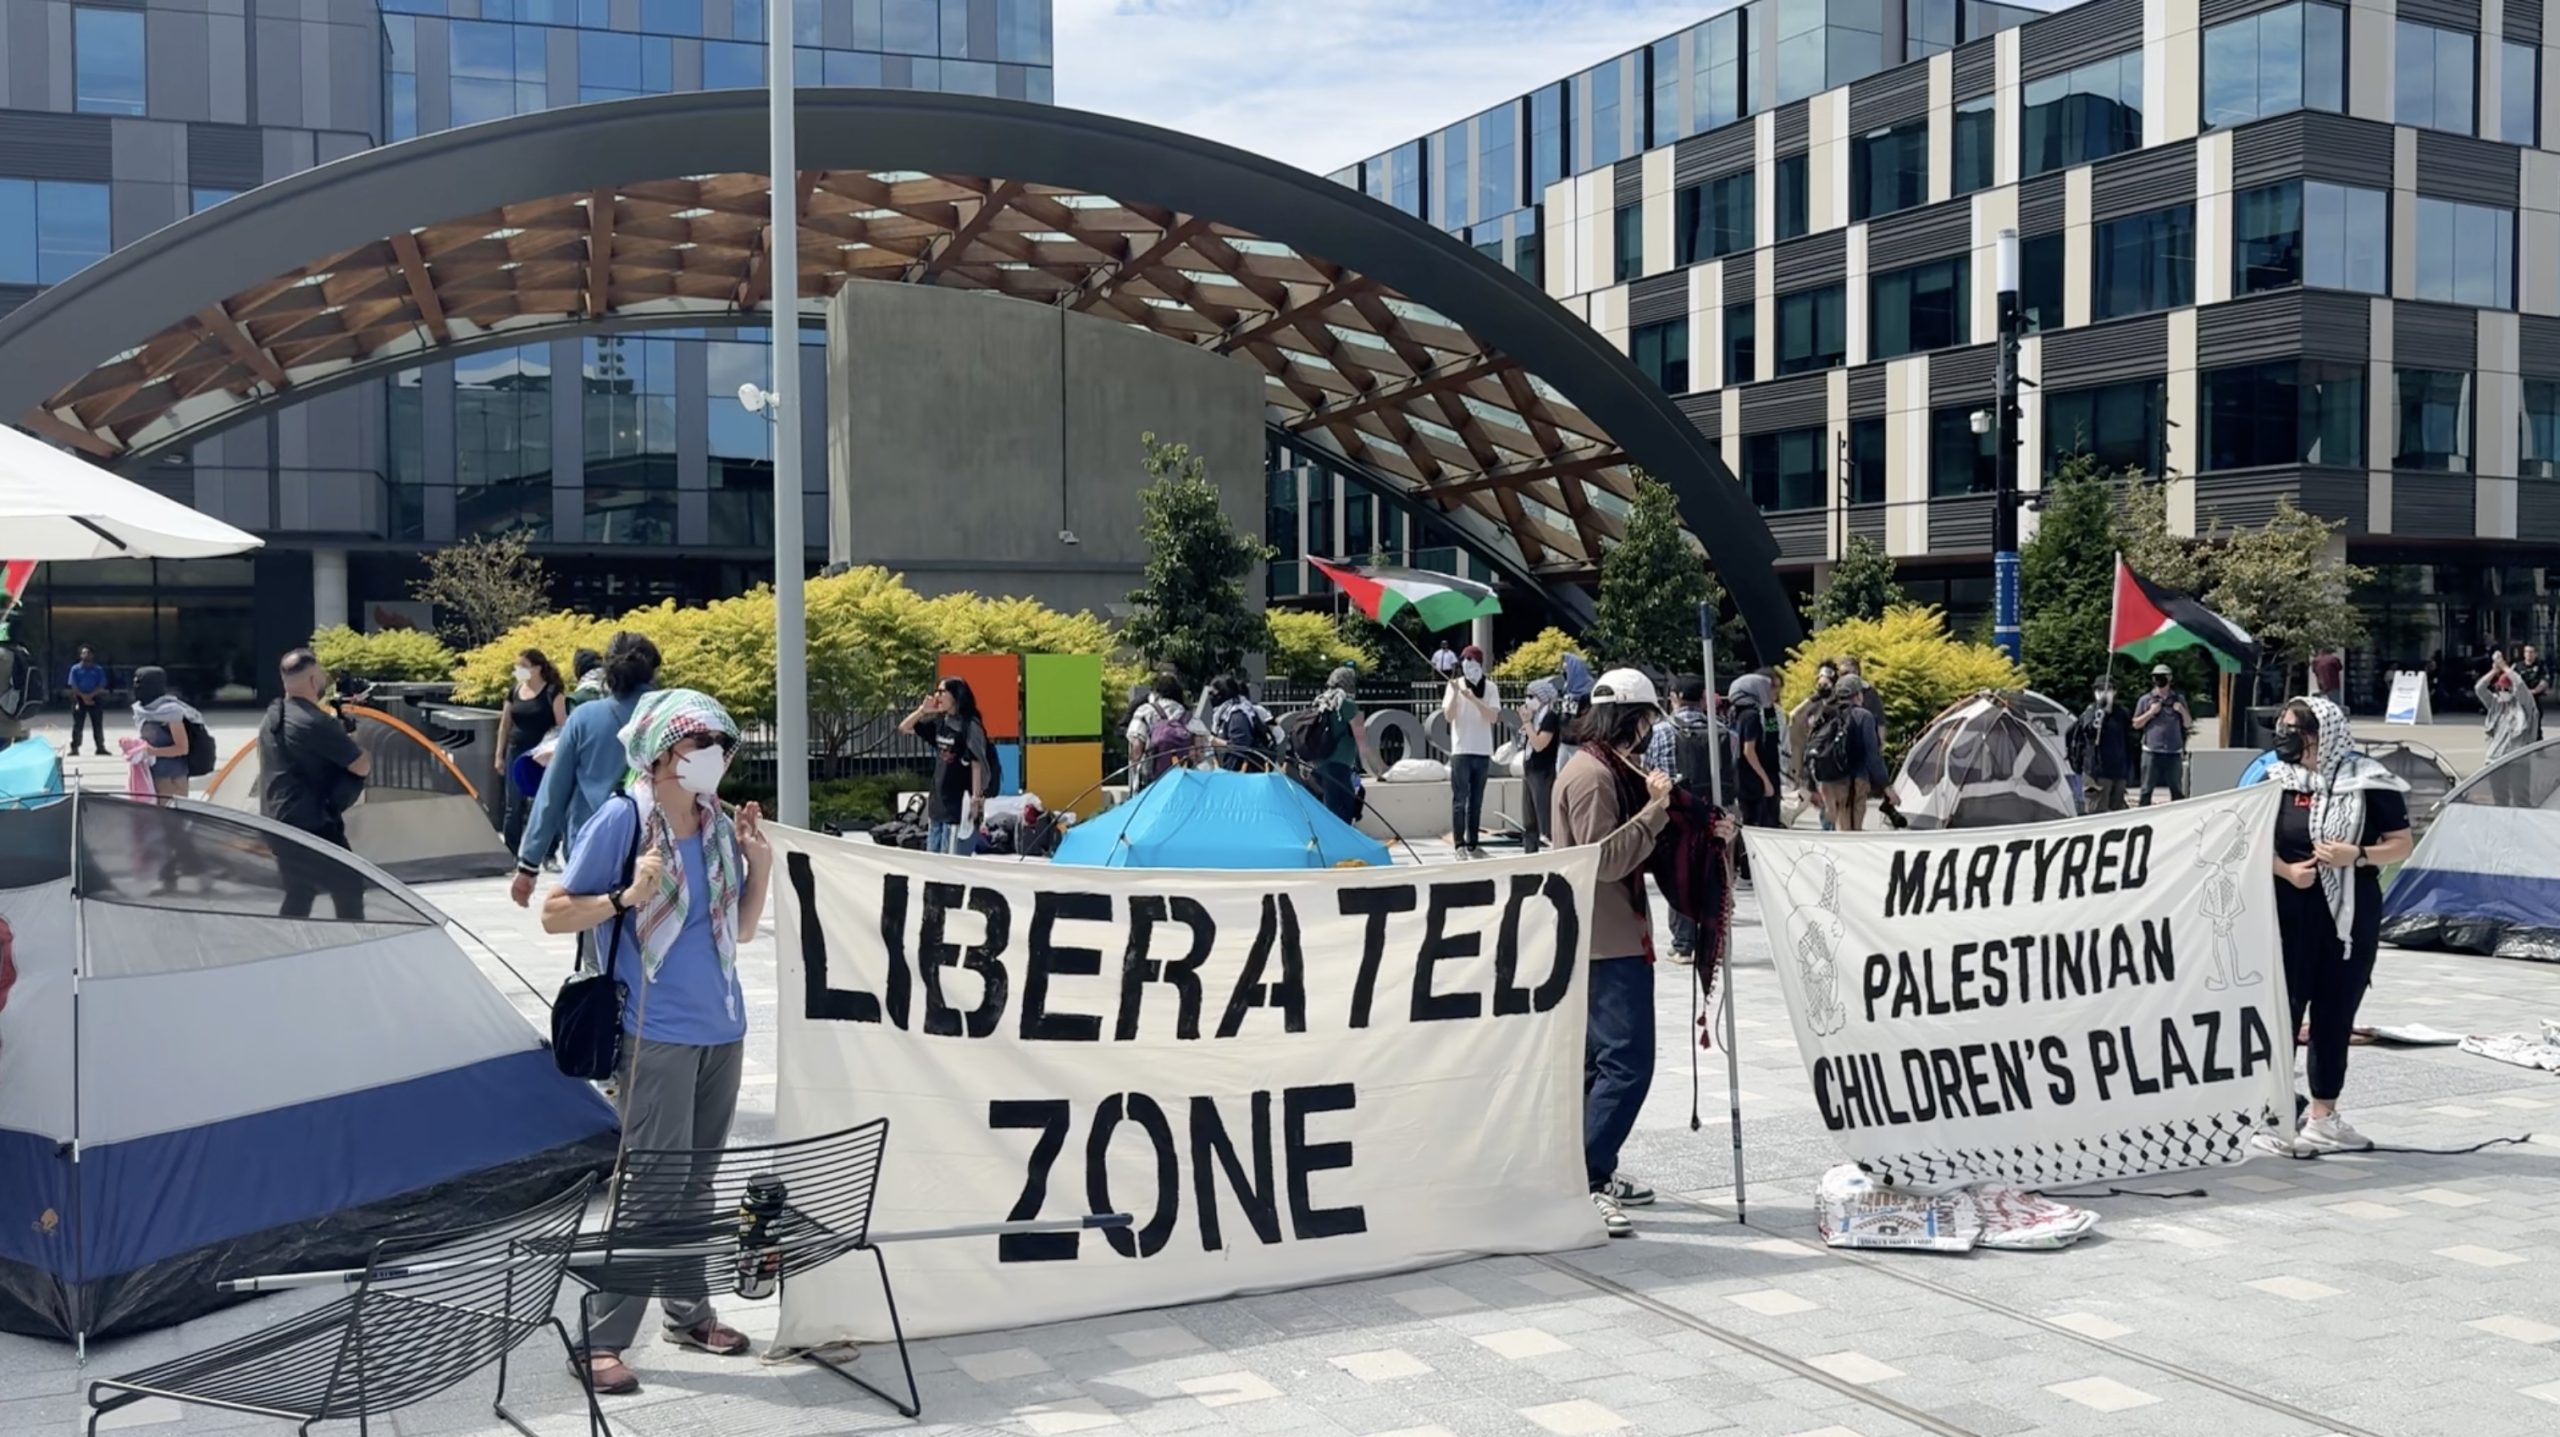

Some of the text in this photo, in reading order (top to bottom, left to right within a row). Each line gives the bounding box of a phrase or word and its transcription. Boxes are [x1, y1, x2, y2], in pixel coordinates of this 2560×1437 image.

[1884, 824, 2153, 918] MARTYRED
[786, 851, 1580, 1042] LIBERATED
[1863, 917, 2175, 1022] PALESTINIAN
[1813, 1005, 2272, 1131] CHILDREN'S PLAZA
[989, 1082, 1368, 1263] ZONE
